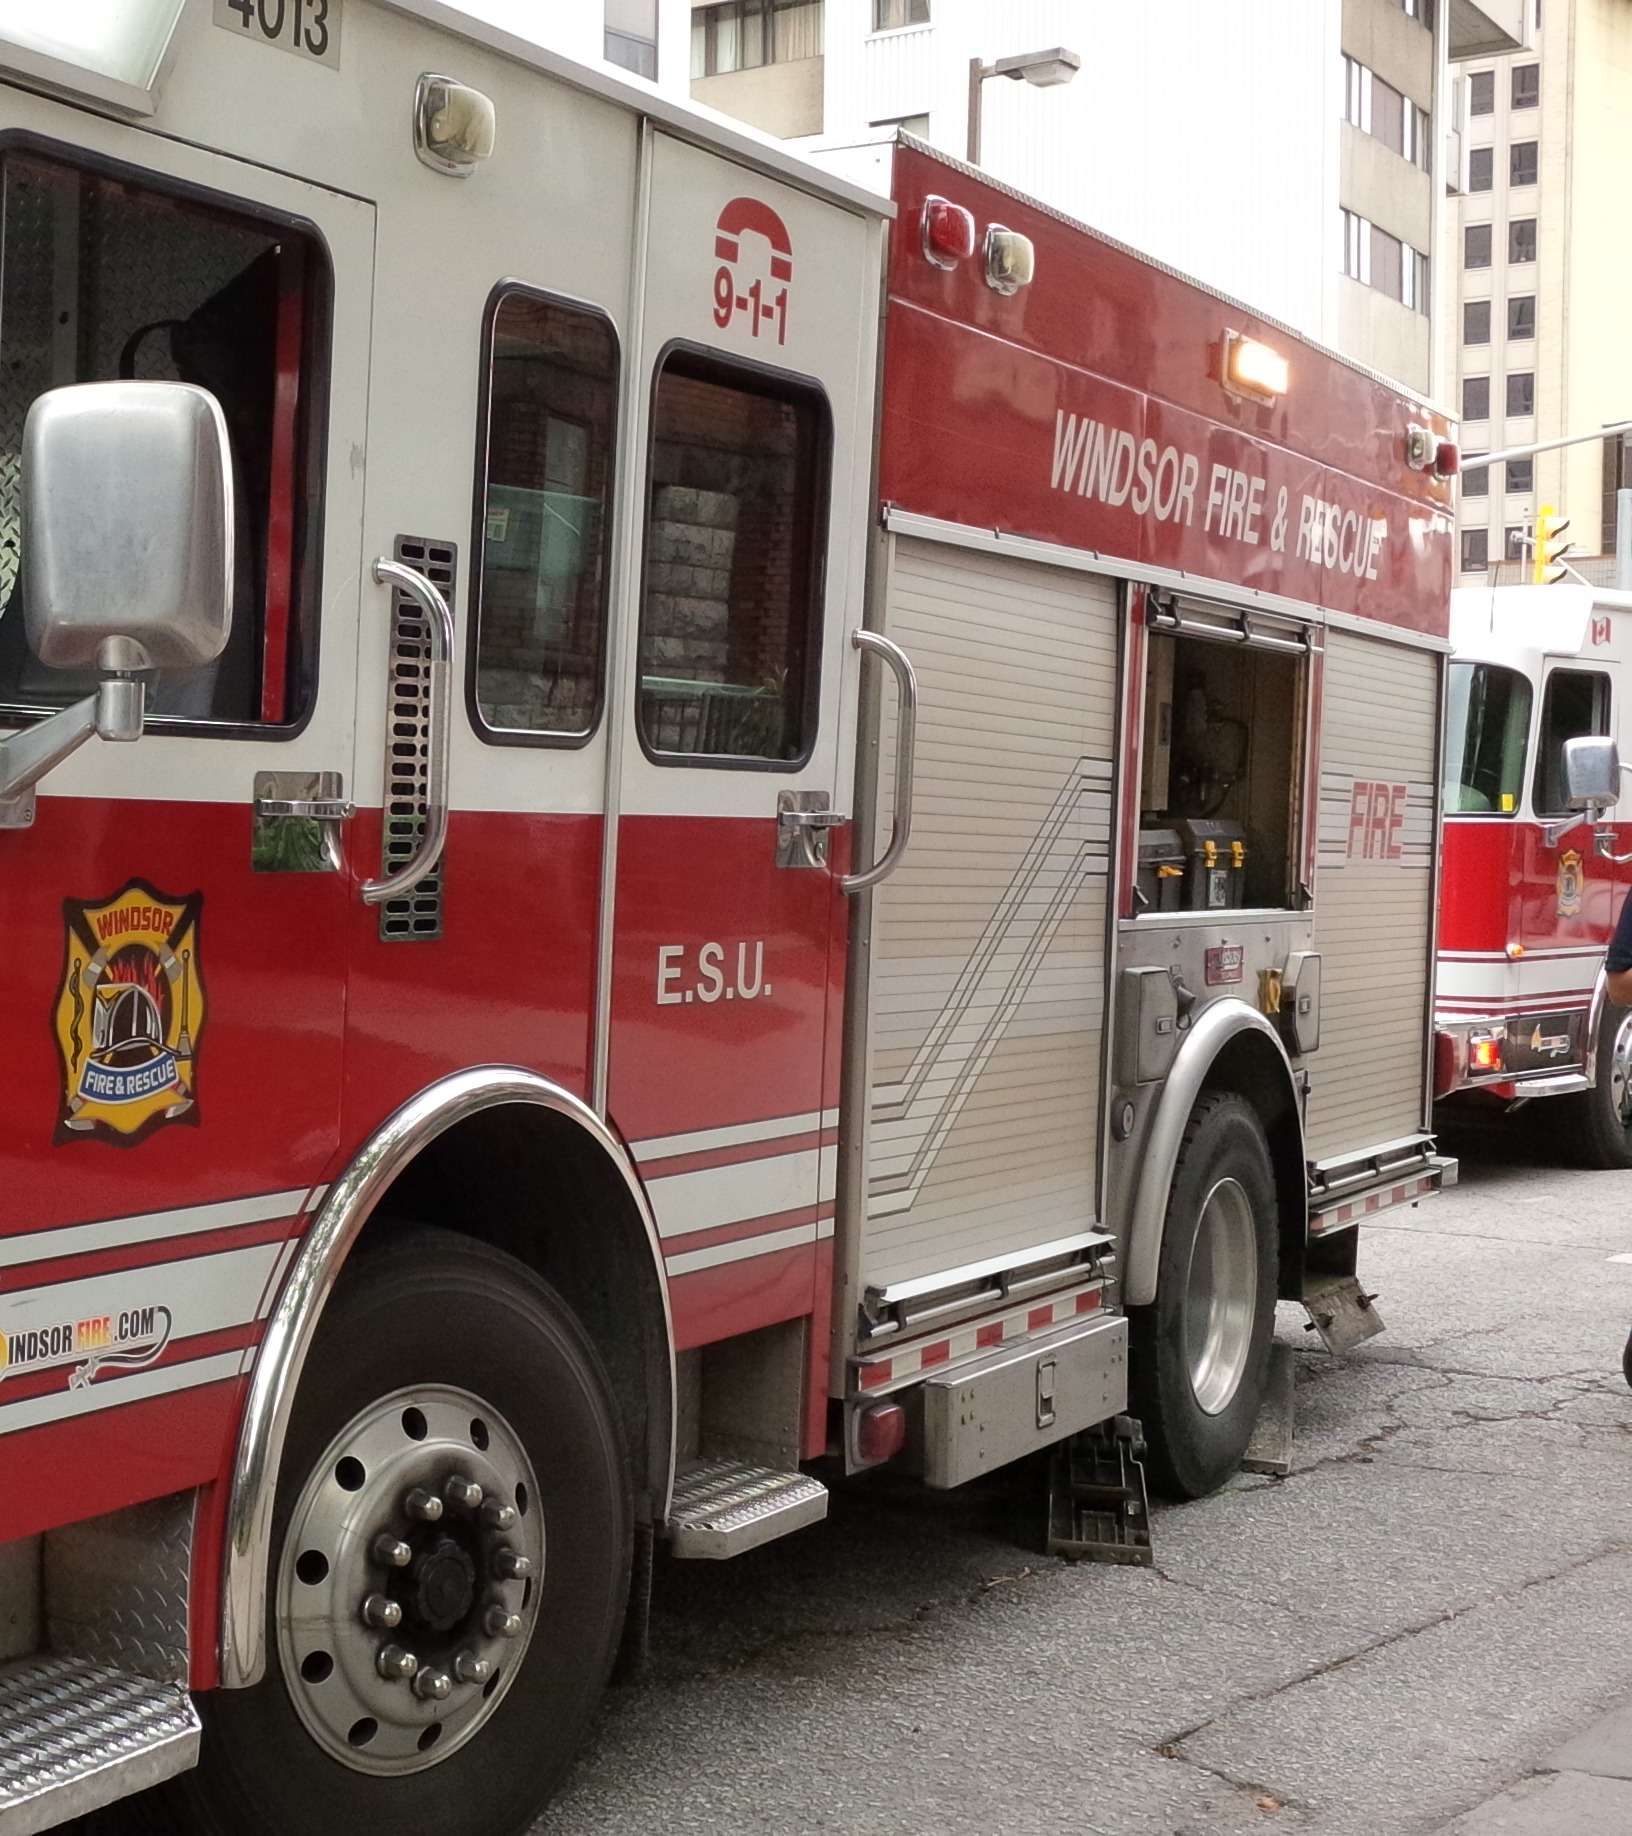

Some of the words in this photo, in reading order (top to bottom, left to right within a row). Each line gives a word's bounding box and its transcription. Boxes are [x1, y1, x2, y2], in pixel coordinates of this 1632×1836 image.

[713, 266, 788, 346] 9-1-1
[1051, 409, 1199, 526] WINDSOR
[1204, 463, 1266, 545] FIRE
[1270, 485, 1289, 553] &
[1296, 494, 1385, 581] RESCUE
[1347, 781, 1407, 860] FIRE
[96, 906, 175, 941] WINDSOR
[656, 940, 772, 1006] E.S.U.
